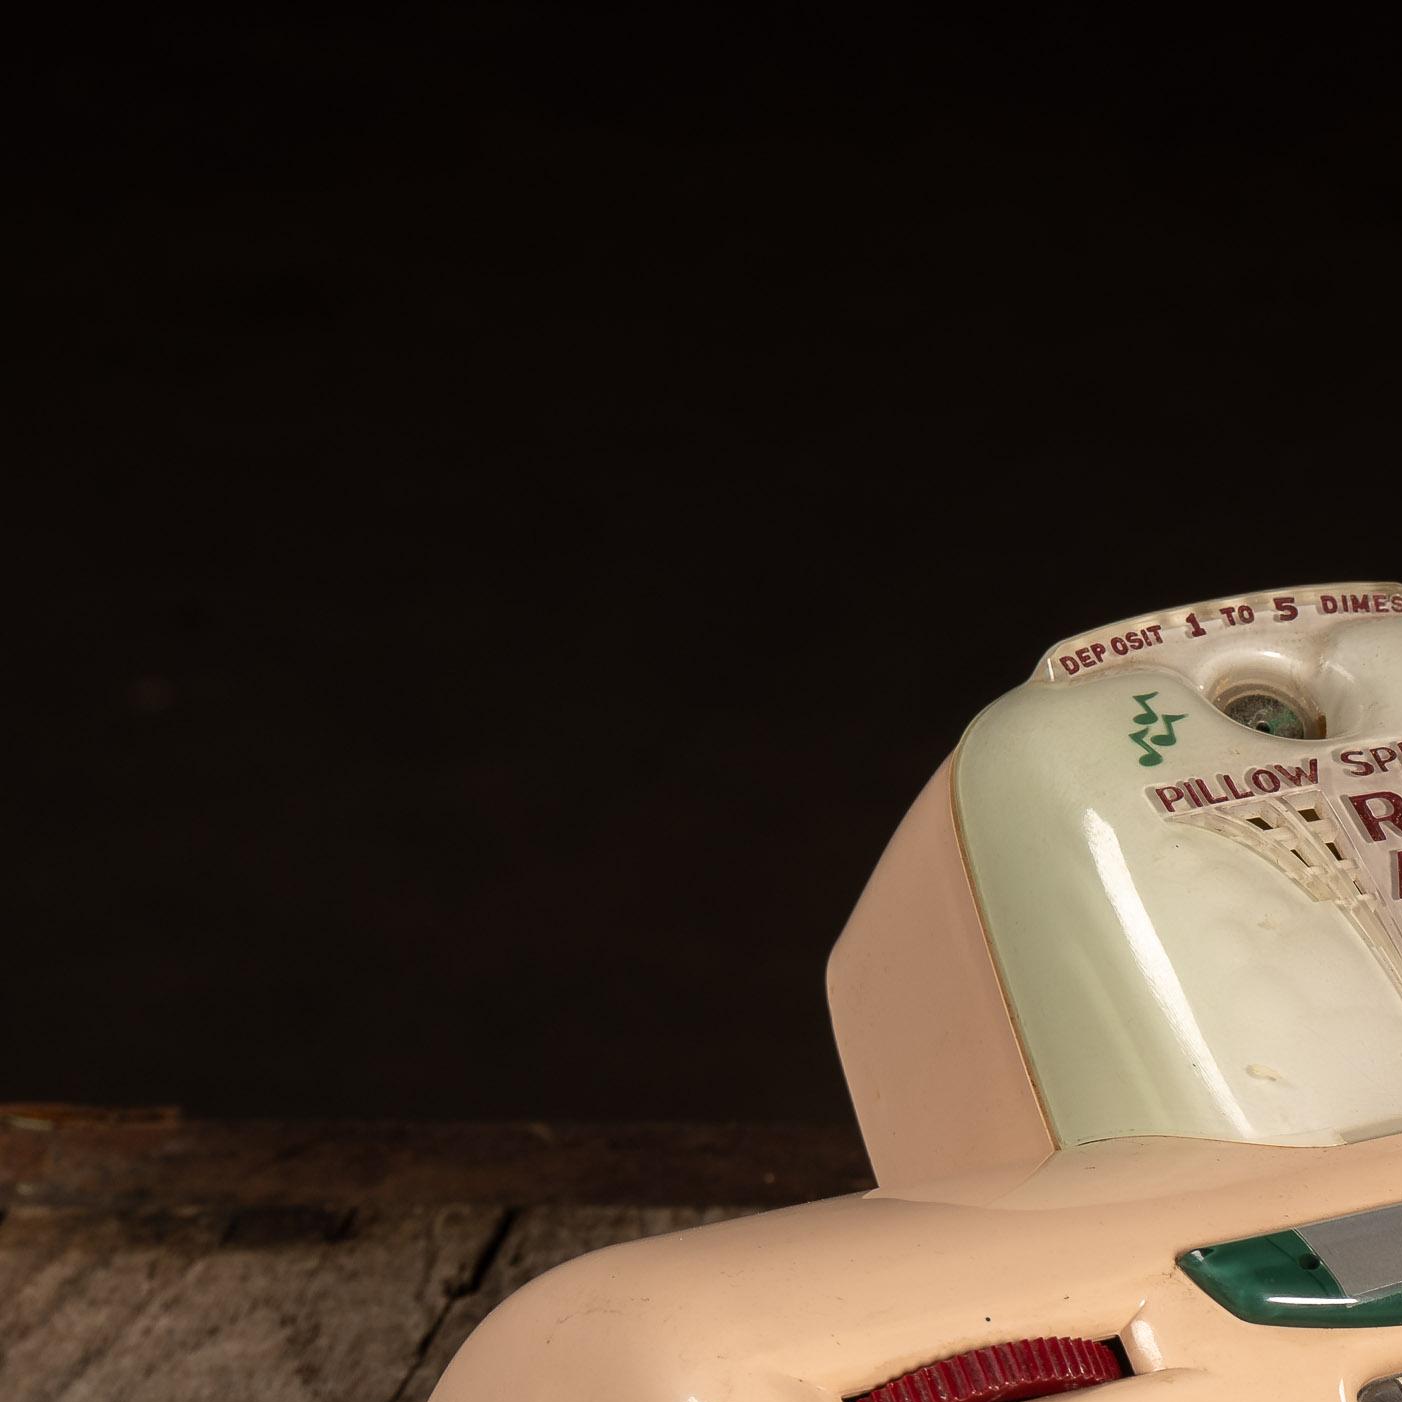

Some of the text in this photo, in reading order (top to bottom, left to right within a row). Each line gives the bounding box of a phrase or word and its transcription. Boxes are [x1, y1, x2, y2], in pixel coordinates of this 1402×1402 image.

[1059, 624, 1163, 676] DEPOSIT
[1185, 612, 1207, 639] 1
[1219, 605, 1255, 628] TO
[1273, 596, 1299, 622] 5
[1154, 757, 1320, 814] PILLOW
